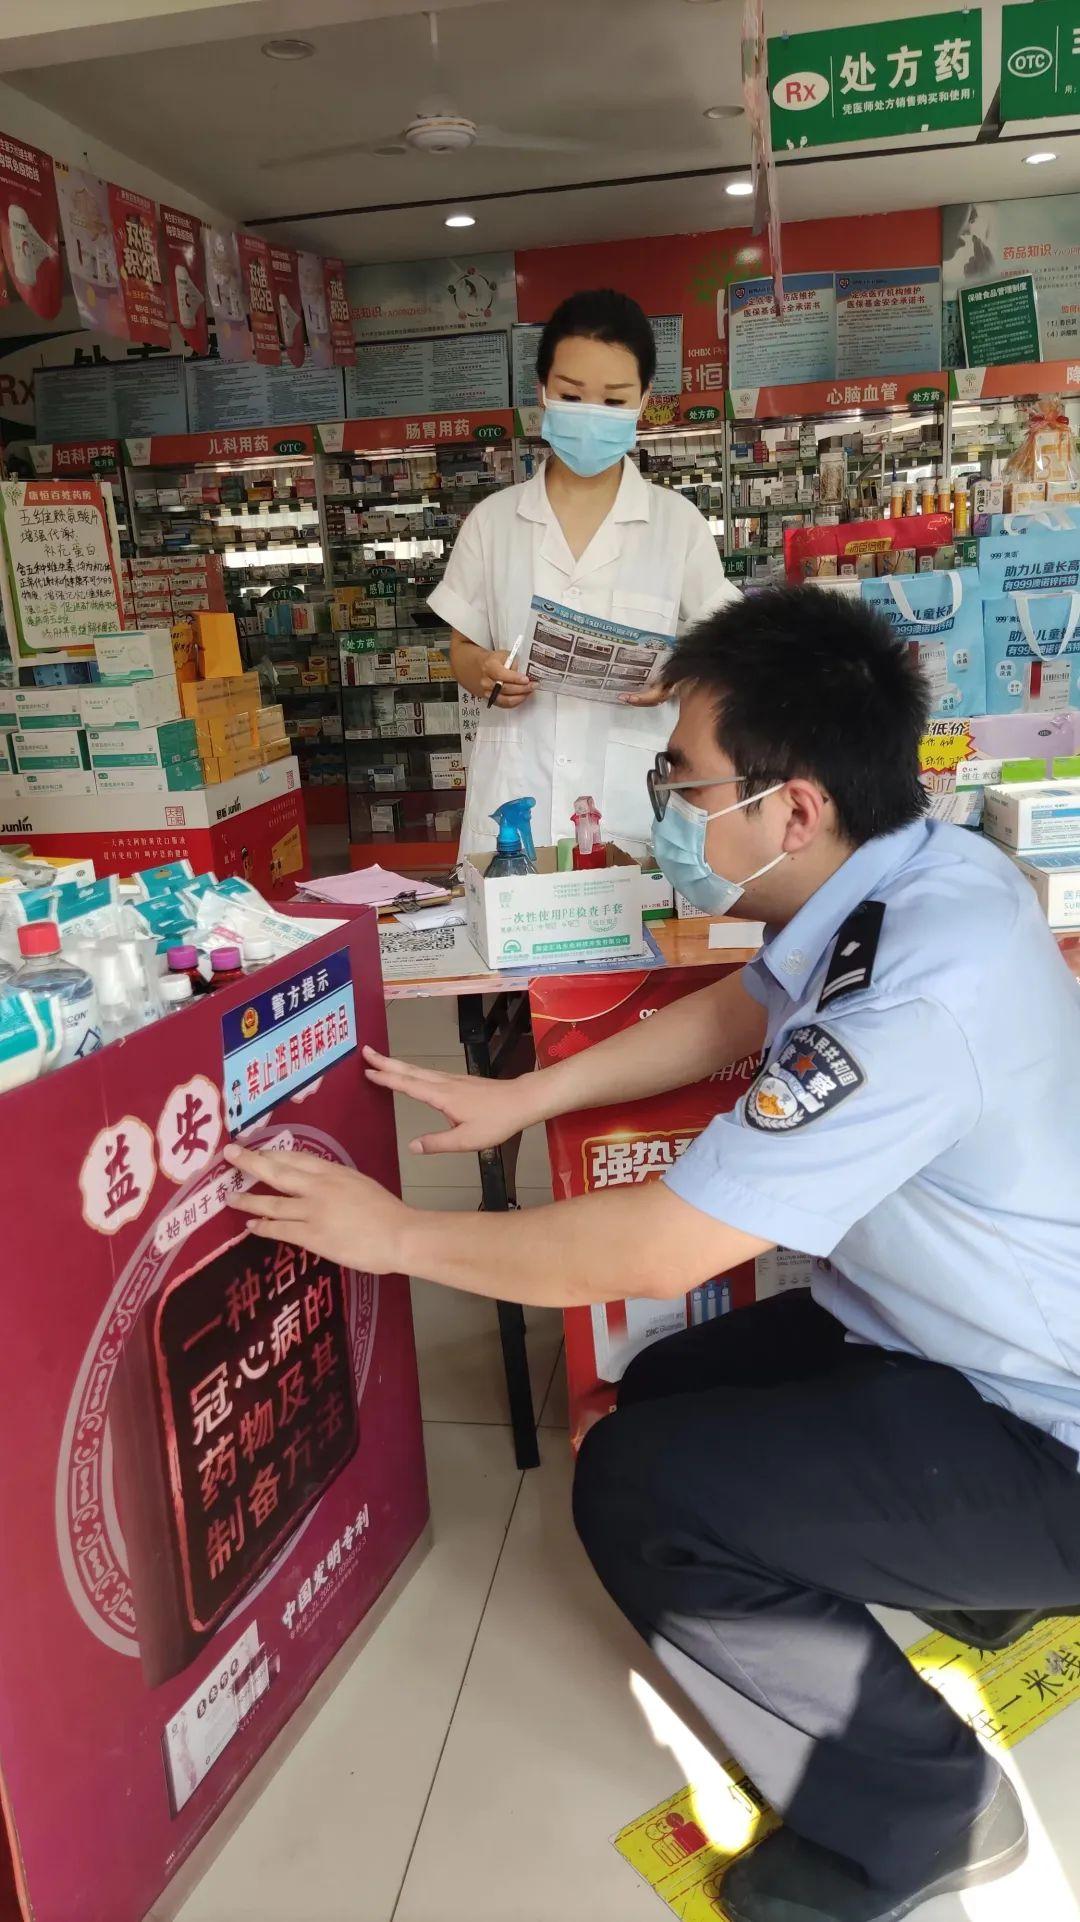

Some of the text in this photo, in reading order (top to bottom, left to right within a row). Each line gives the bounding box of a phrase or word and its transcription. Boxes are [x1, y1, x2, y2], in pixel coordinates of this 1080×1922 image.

[839, 38, 972, 95] 处方药
[1015, 55, 1045, 71] OTC
[785, 81, 816, 104] Rx
[1002, 243, 1053, 263] 药品知识
[746, 290, 817, 307] 定点零药店维护
[846, 295, 926, 310] 医保基金安全承诺书
[826, 383, 898, 406] 心脑血管
[912, 390, 941, 404] 处方药
[688, 409, 715, 420] 处方药
[405, 419, 470, 440] 肠胃用药
[478, 427, 502, 438] OTC
[208, 435, 269, 455] 儿科用药
[279, 442, 301, 454] OTC
[1004, 559, 1080, 578] 助力儿童长高
[346, 638, 376, 649] 处方药
[502, 903, 624, 923] 一次性使用PE检查手套
[271, 967, 330, 1021] 警方提示
[245, 1004, 351, 1104] 禁止滥用精麻药品
[191, 1275, 334, 1446] 冠心病的
[198, 1333, 338, 1513] 药物及其
[207, 1391, 345, 1581] 制备方法
[281, 1502, 370, 1630] 中国发明专利
